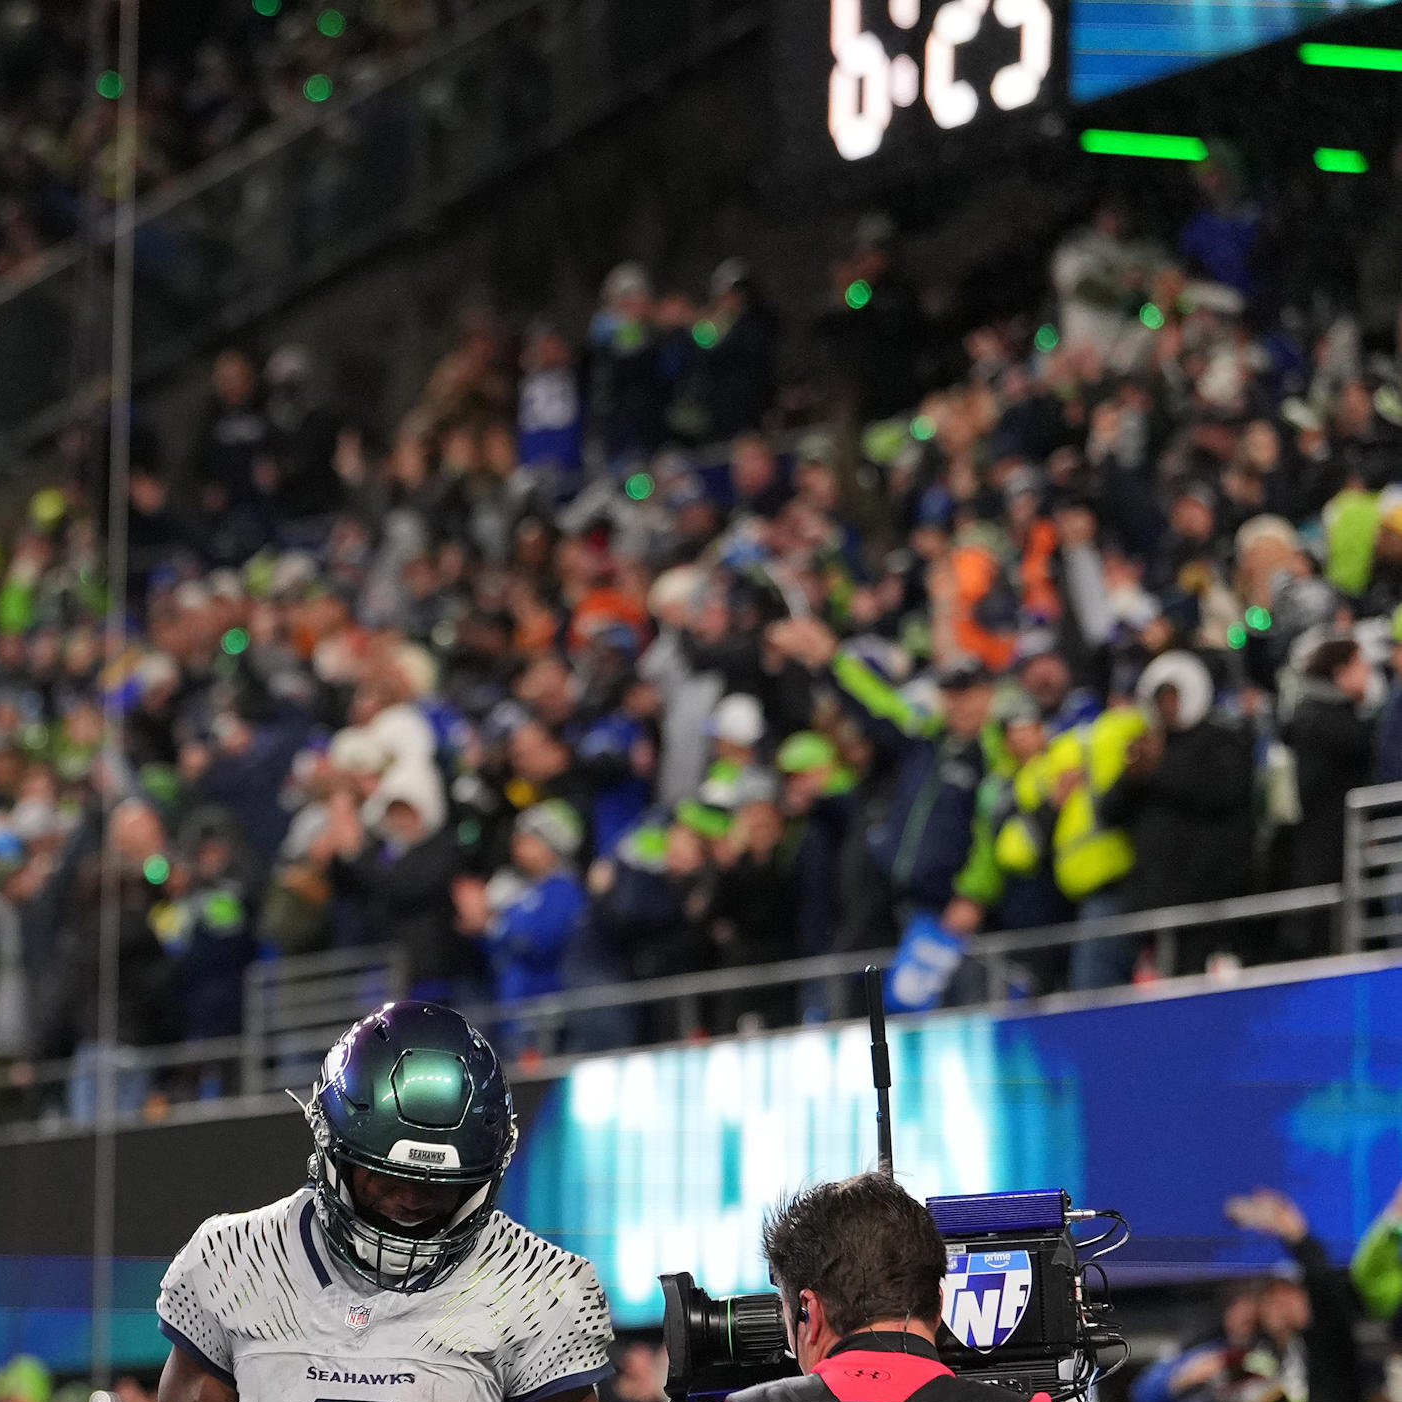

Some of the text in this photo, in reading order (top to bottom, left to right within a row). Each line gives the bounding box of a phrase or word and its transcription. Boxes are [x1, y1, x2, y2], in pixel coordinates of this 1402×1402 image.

[408, 1148, 446, 1164] SEAHAWKS
[984, 1252, 1012, 1264] prime
[306, 1366, 416, 1385] SEAHAWKS
